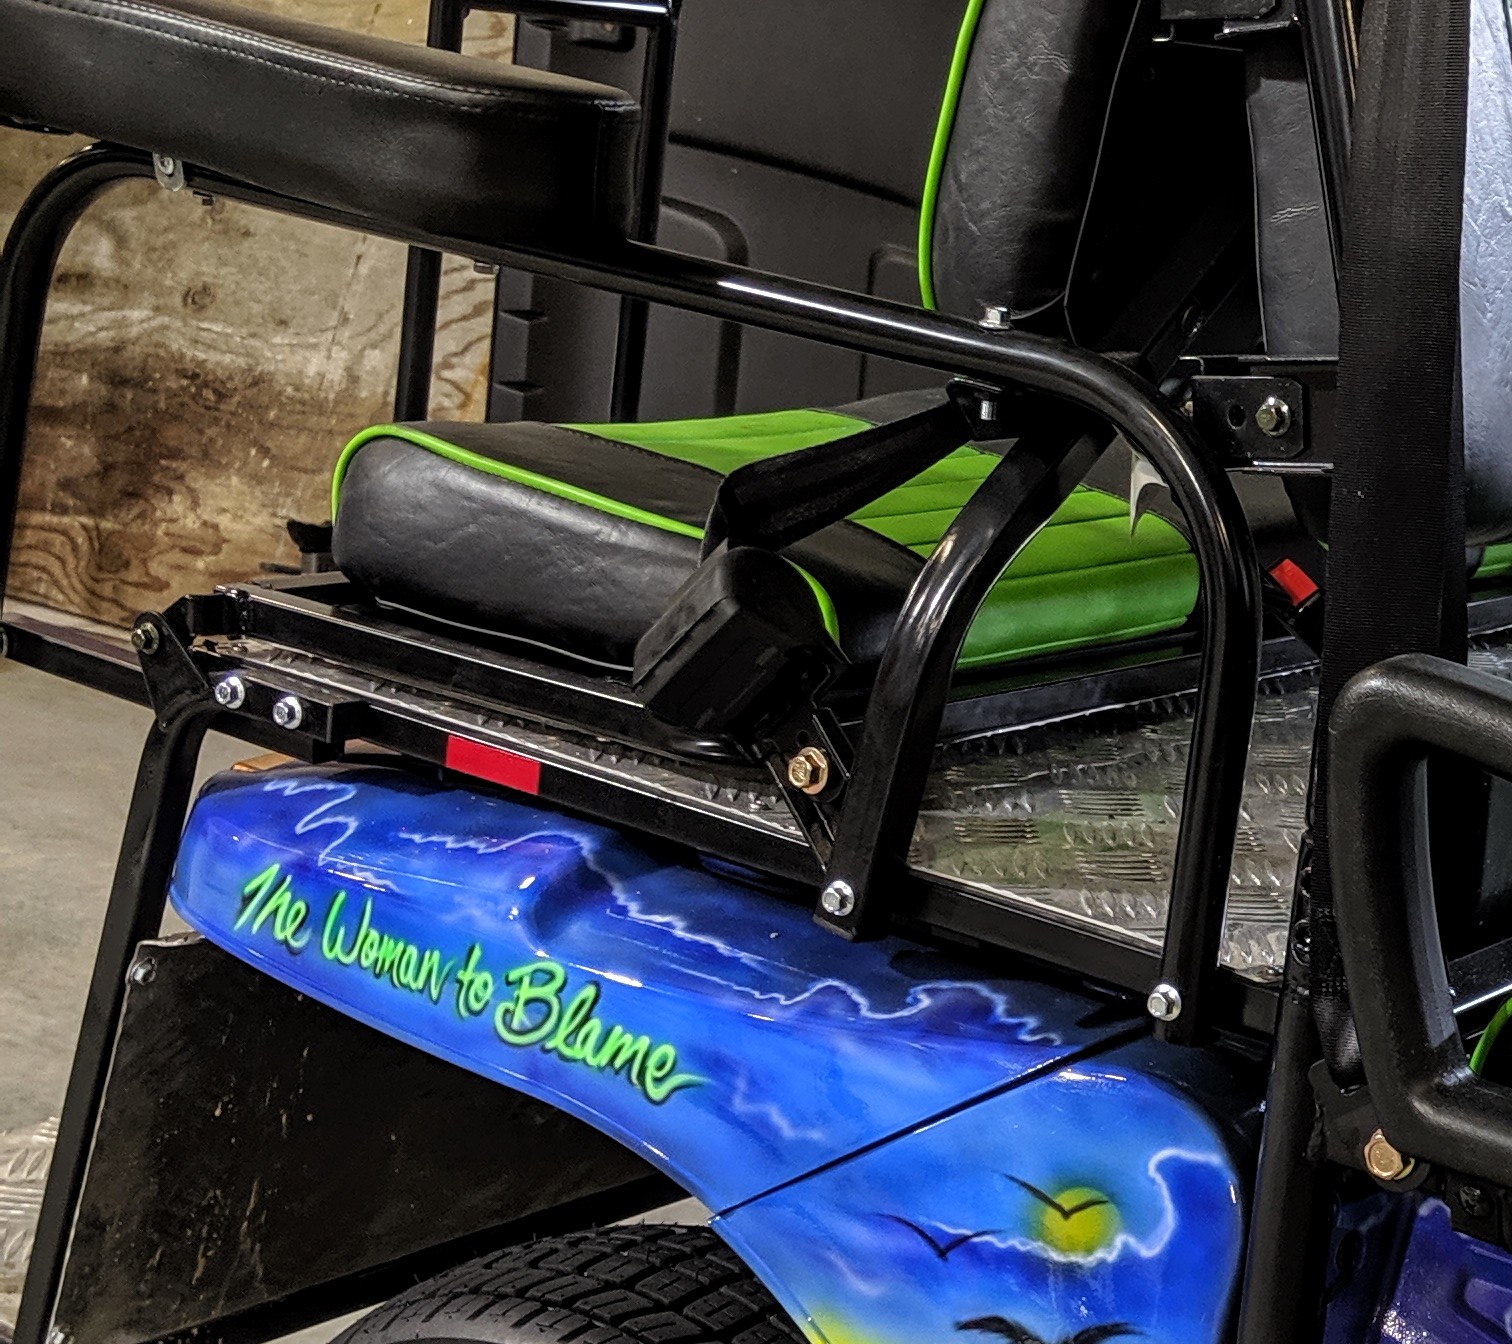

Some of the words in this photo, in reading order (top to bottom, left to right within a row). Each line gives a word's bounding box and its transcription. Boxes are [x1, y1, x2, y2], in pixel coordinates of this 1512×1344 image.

[233, 862, 312, 950] The
[321, 889, 455, 1003] Woman
[455, 942, 495, 1020] to
[494, 960, 712, 1104] Blame
